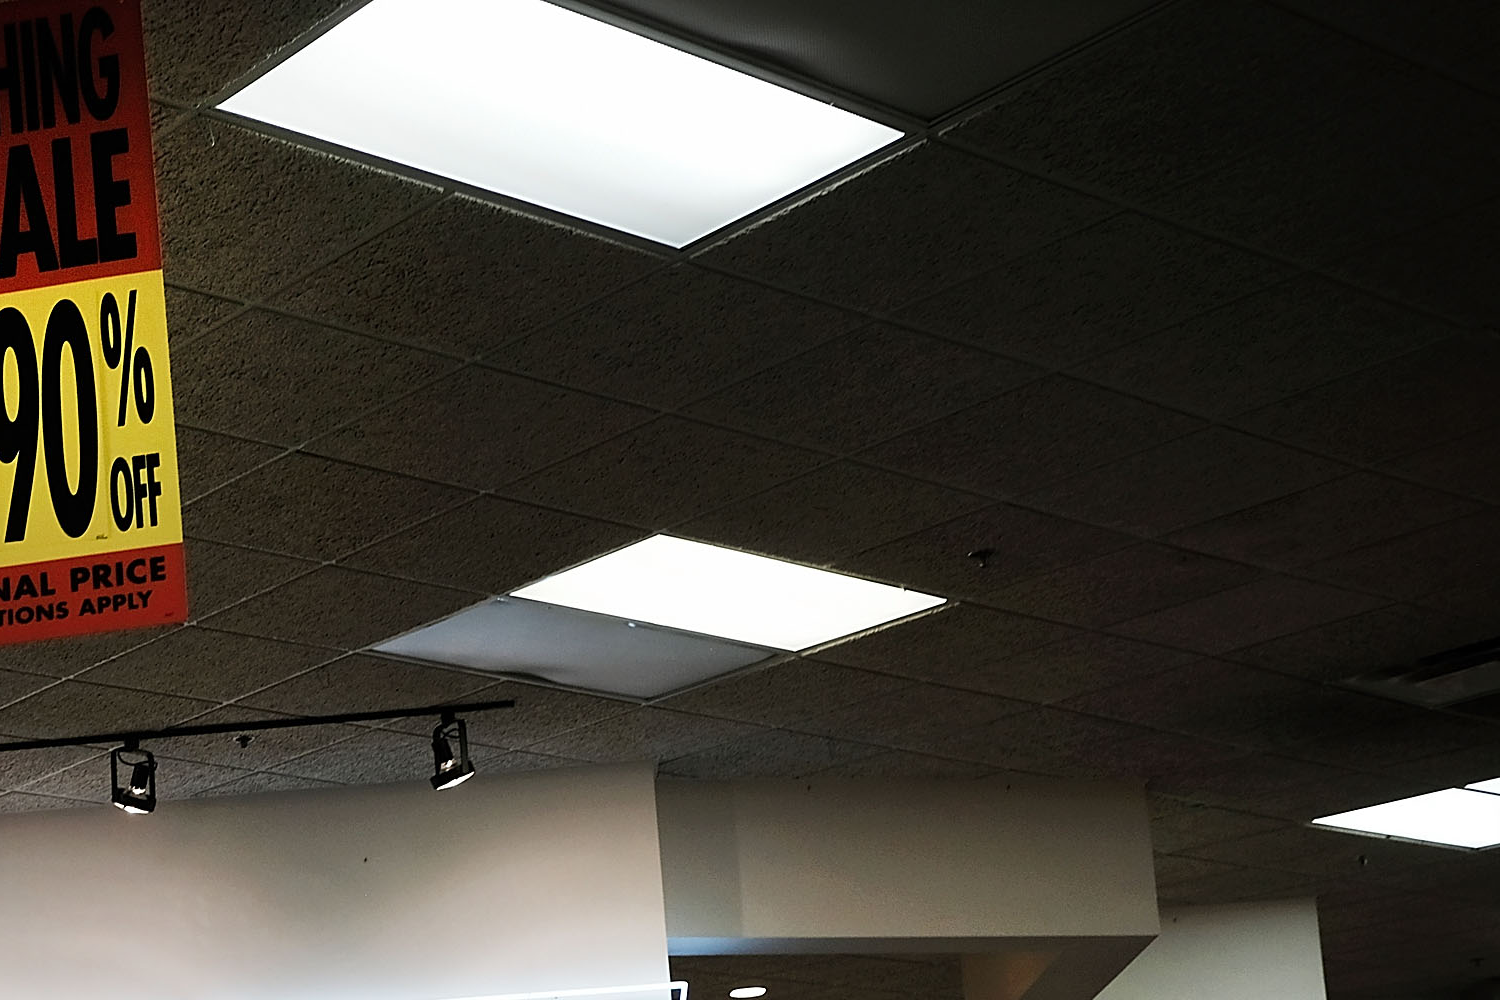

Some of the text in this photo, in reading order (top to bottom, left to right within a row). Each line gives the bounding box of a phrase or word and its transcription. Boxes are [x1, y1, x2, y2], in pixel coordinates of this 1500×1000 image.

[110, 453, 162, 532] OFF
[70, 556, 167, 593] PRICE
[79, 590, 153, 616] APPLY
